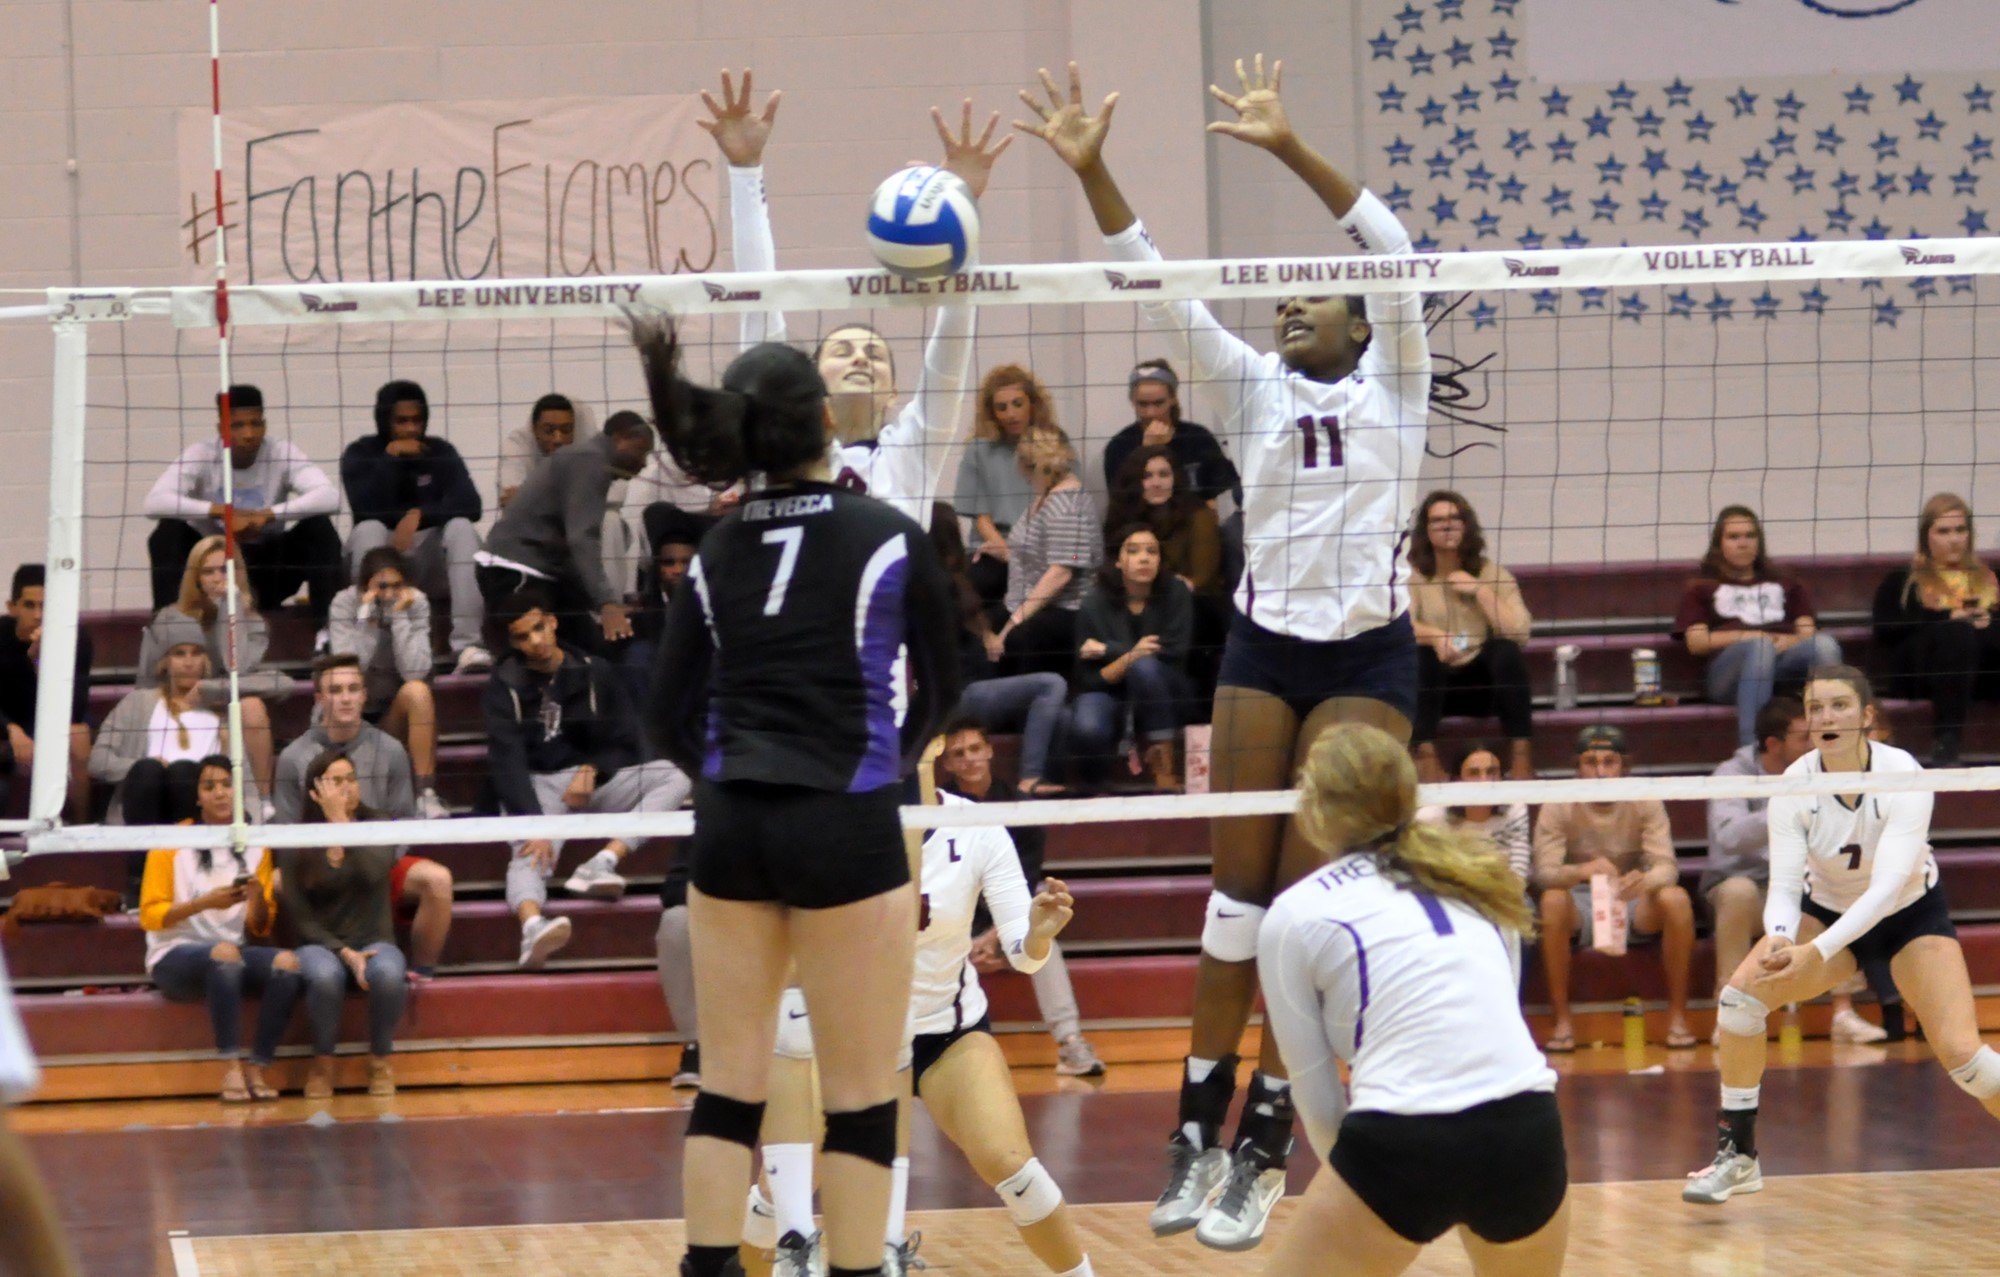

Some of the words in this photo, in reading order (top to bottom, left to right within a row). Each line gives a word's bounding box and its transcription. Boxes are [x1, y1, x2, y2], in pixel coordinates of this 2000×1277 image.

[1221, 265, 1269, 285] LEE
[1277, 259, 1442, 284] UNIVERSITY
[1644, 247, 1815, 271] VOLLEYBALL
[417, 288, 467, 308] LEE
[474, 283, 642, 306] UNIVERSITY
[1297, 414, 1344, 468] 11
[761, 525, 804, 617] 7
[1839, 844, 1862, 870] 7
